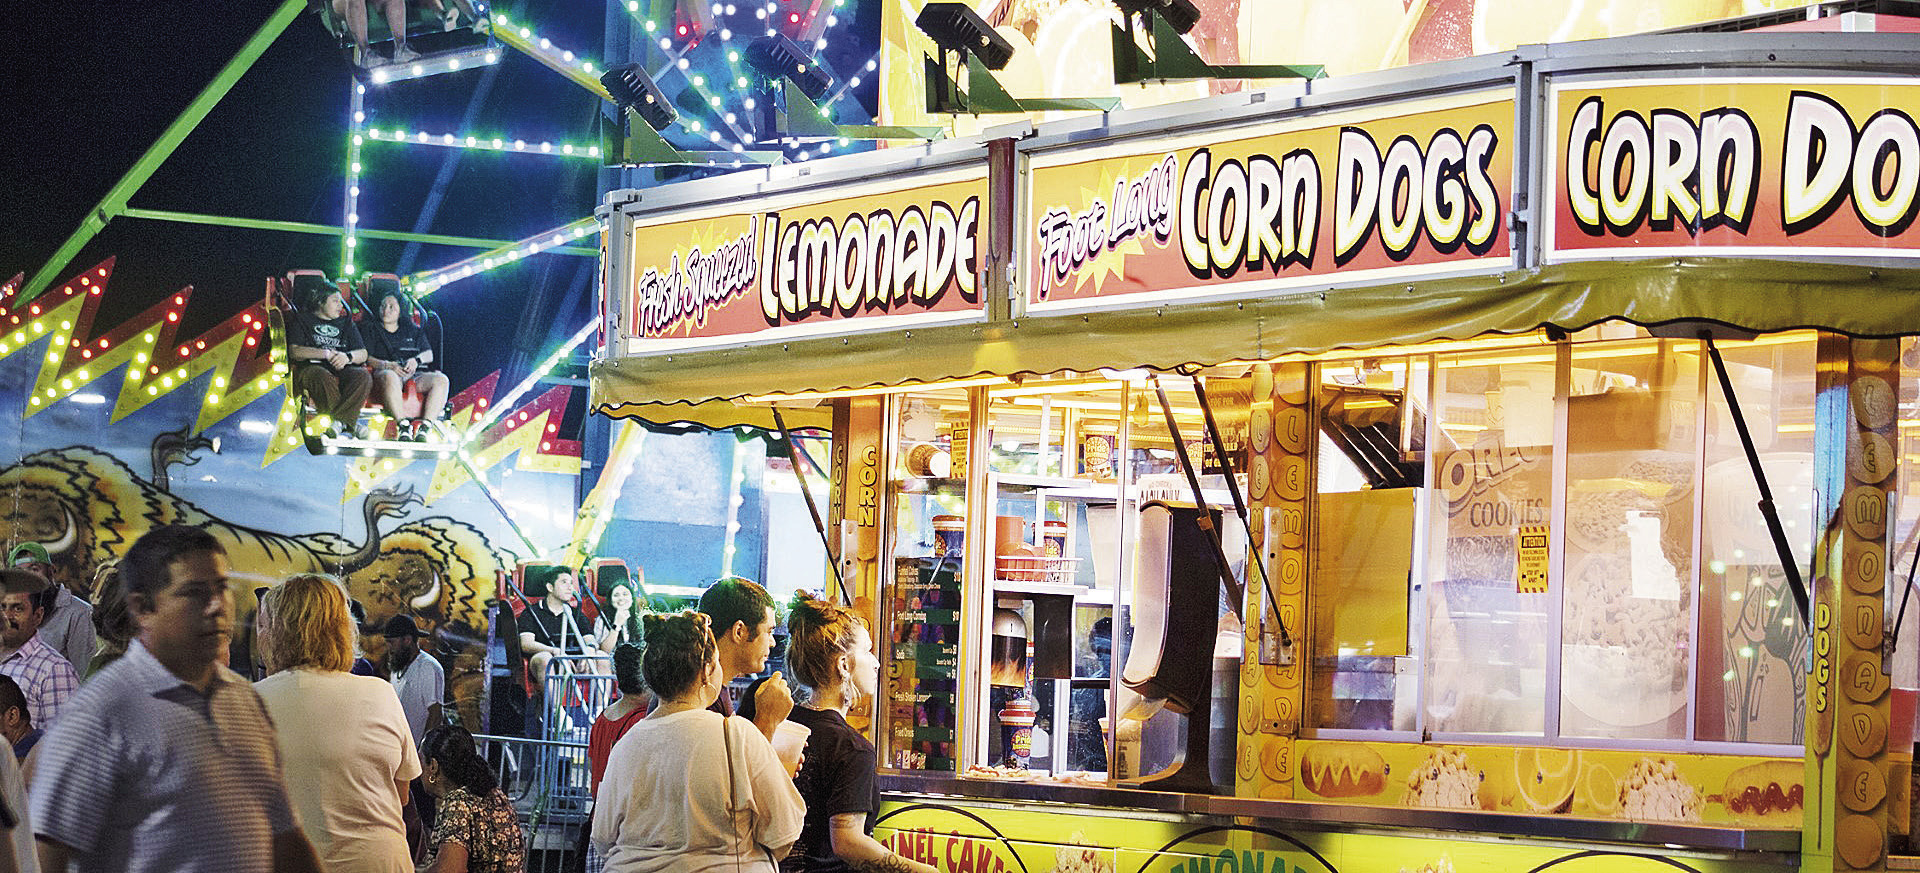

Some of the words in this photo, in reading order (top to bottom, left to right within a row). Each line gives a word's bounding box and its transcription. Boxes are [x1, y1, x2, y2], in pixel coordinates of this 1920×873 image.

[1038, 202, 1106, 300] Foot
[1107, 153, 1178, 248] Long
[1179, 148, 1322, 279] CORN
[1335, 124, 1499, 267] DOGS
[1567, 96, 1761, 237] CORN
[638, 250, 683, 337] Fresh
[683, 215, 758, 321] Squeezed
[760, 195, 981, 327] LEMONADE
[833, 445, 843, 527] CORN
[858, 445, 877, 527] CORN
[1471, 498, 1544, 528] COOKIES
[1815, 601, 1832, 714] DOGS
